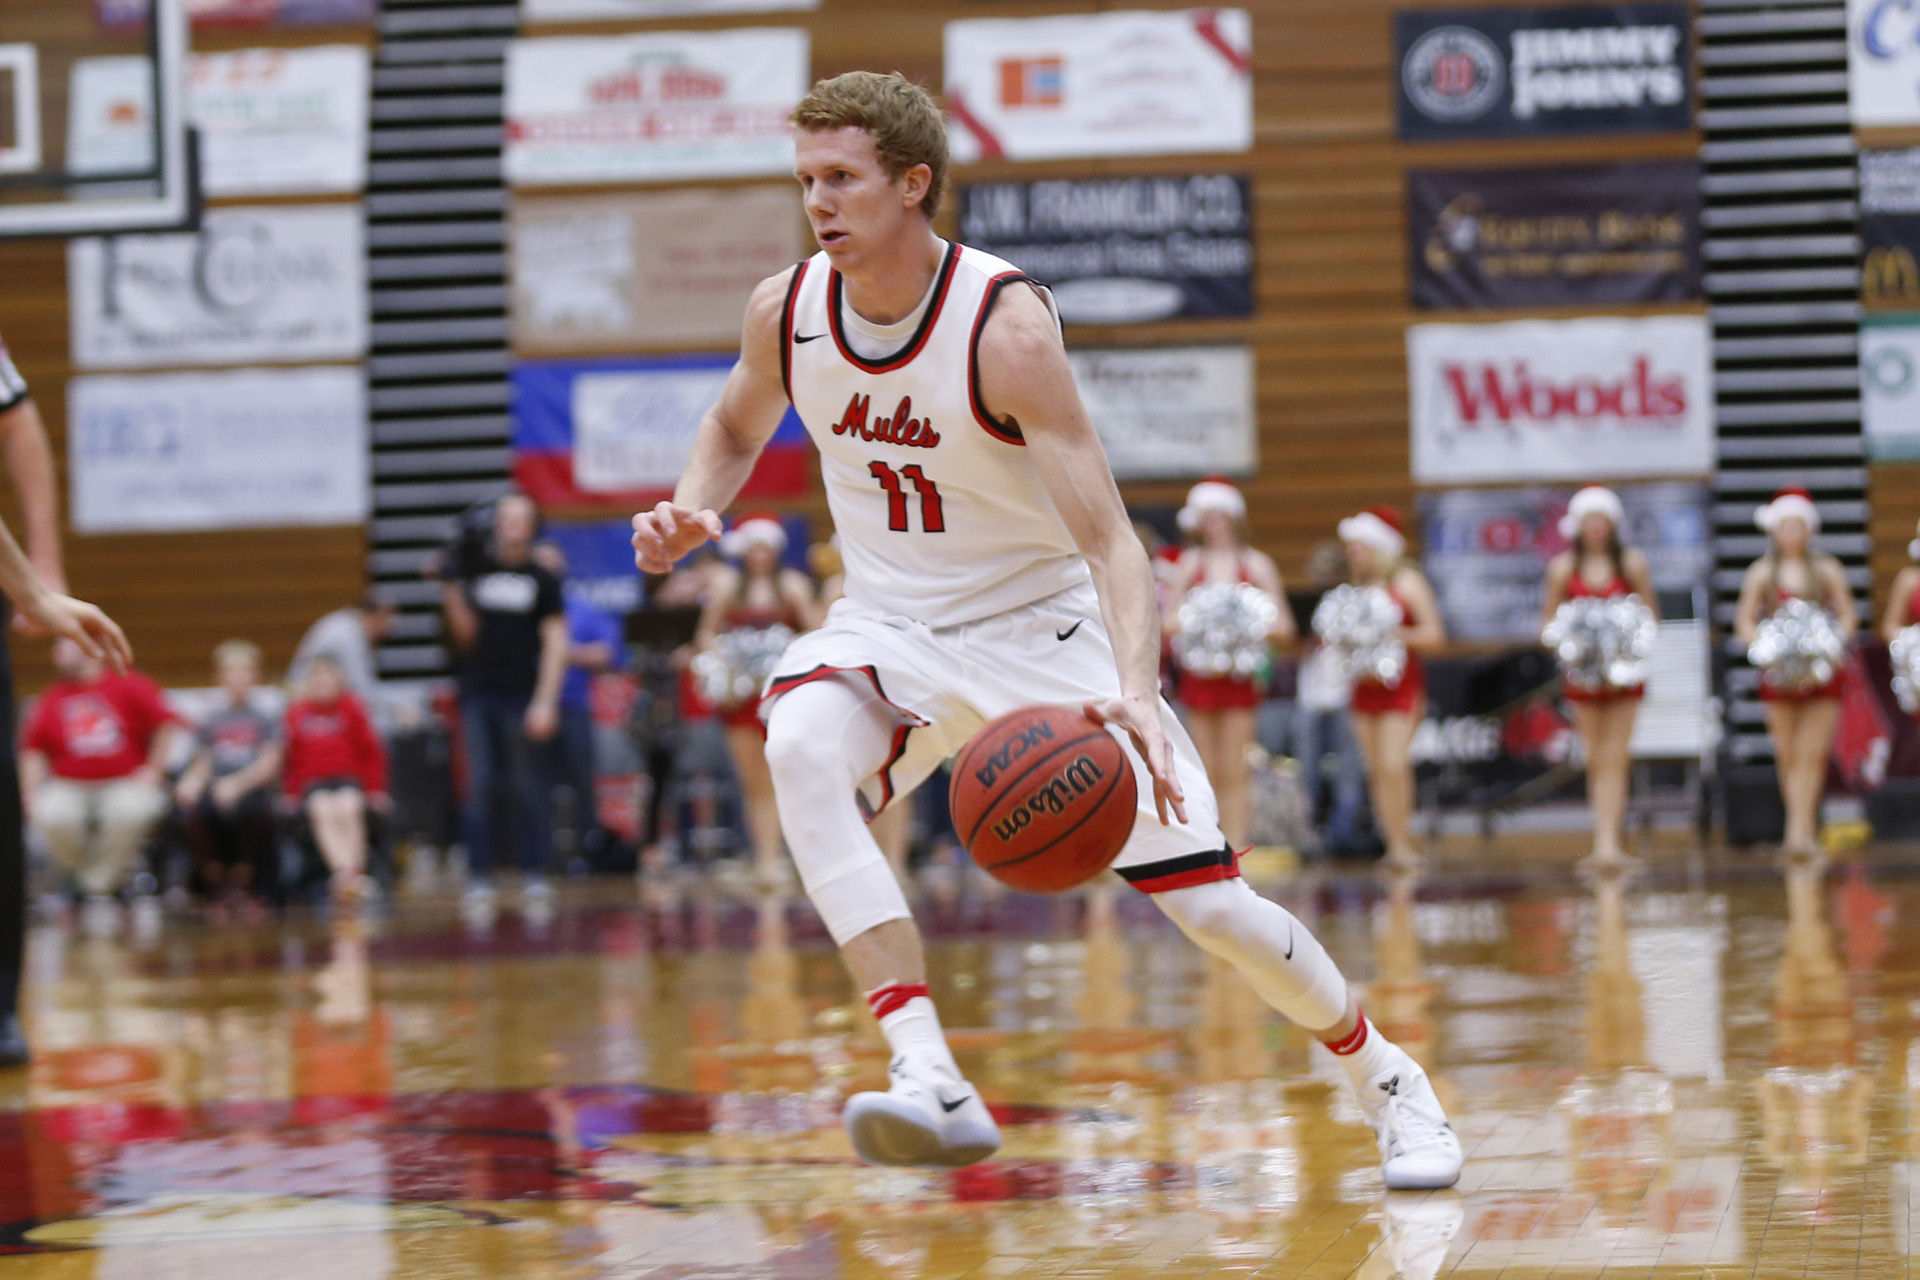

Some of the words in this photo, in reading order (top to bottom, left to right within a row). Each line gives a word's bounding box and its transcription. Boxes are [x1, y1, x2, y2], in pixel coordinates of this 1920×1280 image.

[1511, 26, 1681, 67] JIMMY
[1511, 66, 1684, 120] JOHN'S
[1029, 179, 1182, 232] FRANKLIN
[832, 392, 940, 448] Mules
[1443, 353, 1686, 425] Woods
[867, 460, 945, 532] 11
[976, 720, 1054, 789] NCAA
[992, 755, 1104, 841] Wilson
